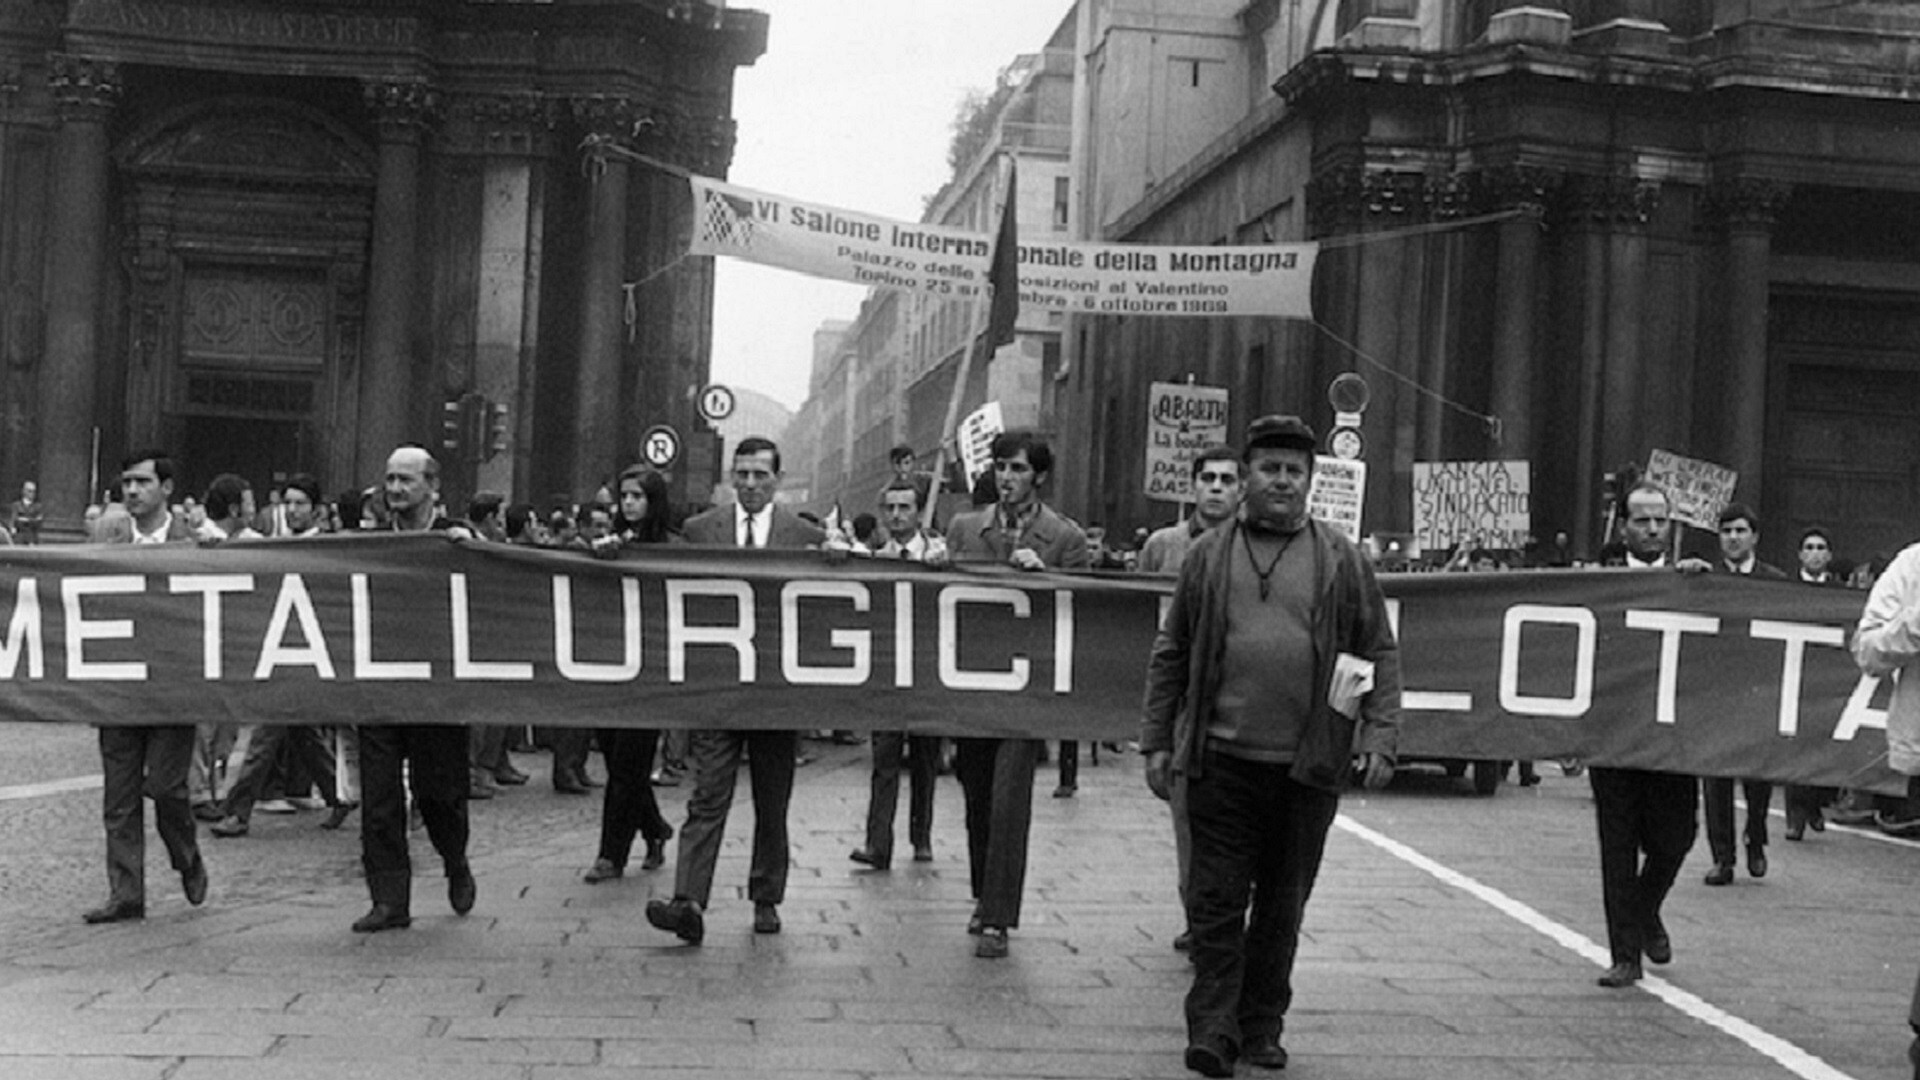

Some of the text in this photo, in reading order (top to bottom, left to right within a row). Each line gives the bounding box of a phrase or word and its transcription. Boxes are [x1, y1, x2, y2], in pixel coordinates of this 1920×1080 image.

[790, 206, 881, 241] Salone
[891, 224, 1084, 268] Internaonale
[1094, 250, 1158, 272] della
[1169, 251, 1299, 277] Montagna
[837, 245, 917, 272] Palazzo
[924, 260, 975, 281] delle
[1135, 282, 1229, 296] Valentino
[852, 265, 917, 288] Torino
[925, 279, 952, 295] 25
[1084, 297, 1096, 309] 6
[1100, 297, 1178, 313] ottobre
[1158, 394, 1227, 423] ABARTH
[1420, 493, 1530, 515] SINDACATO
